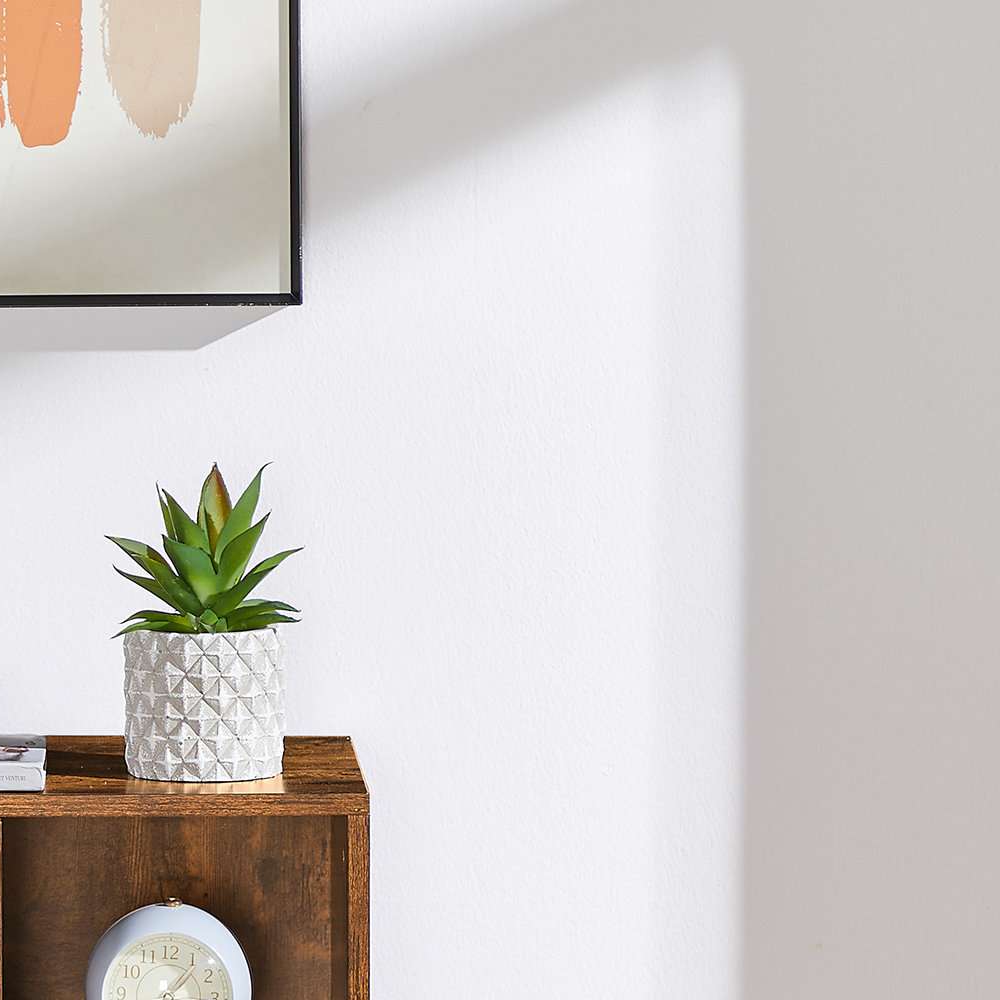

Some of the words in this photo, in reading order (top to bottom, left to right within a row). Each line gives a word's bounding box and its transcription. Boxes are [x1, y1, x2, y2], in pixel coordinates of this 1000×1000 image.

[140, 950, 156, 964] 11
[162, 945, 179, 960] 12
[189, 952, 195, 967] 1
[123, 964, 141, 979] 10
[204, 968, 213, 984] 2
[116, 986, 126, 1000] 9
